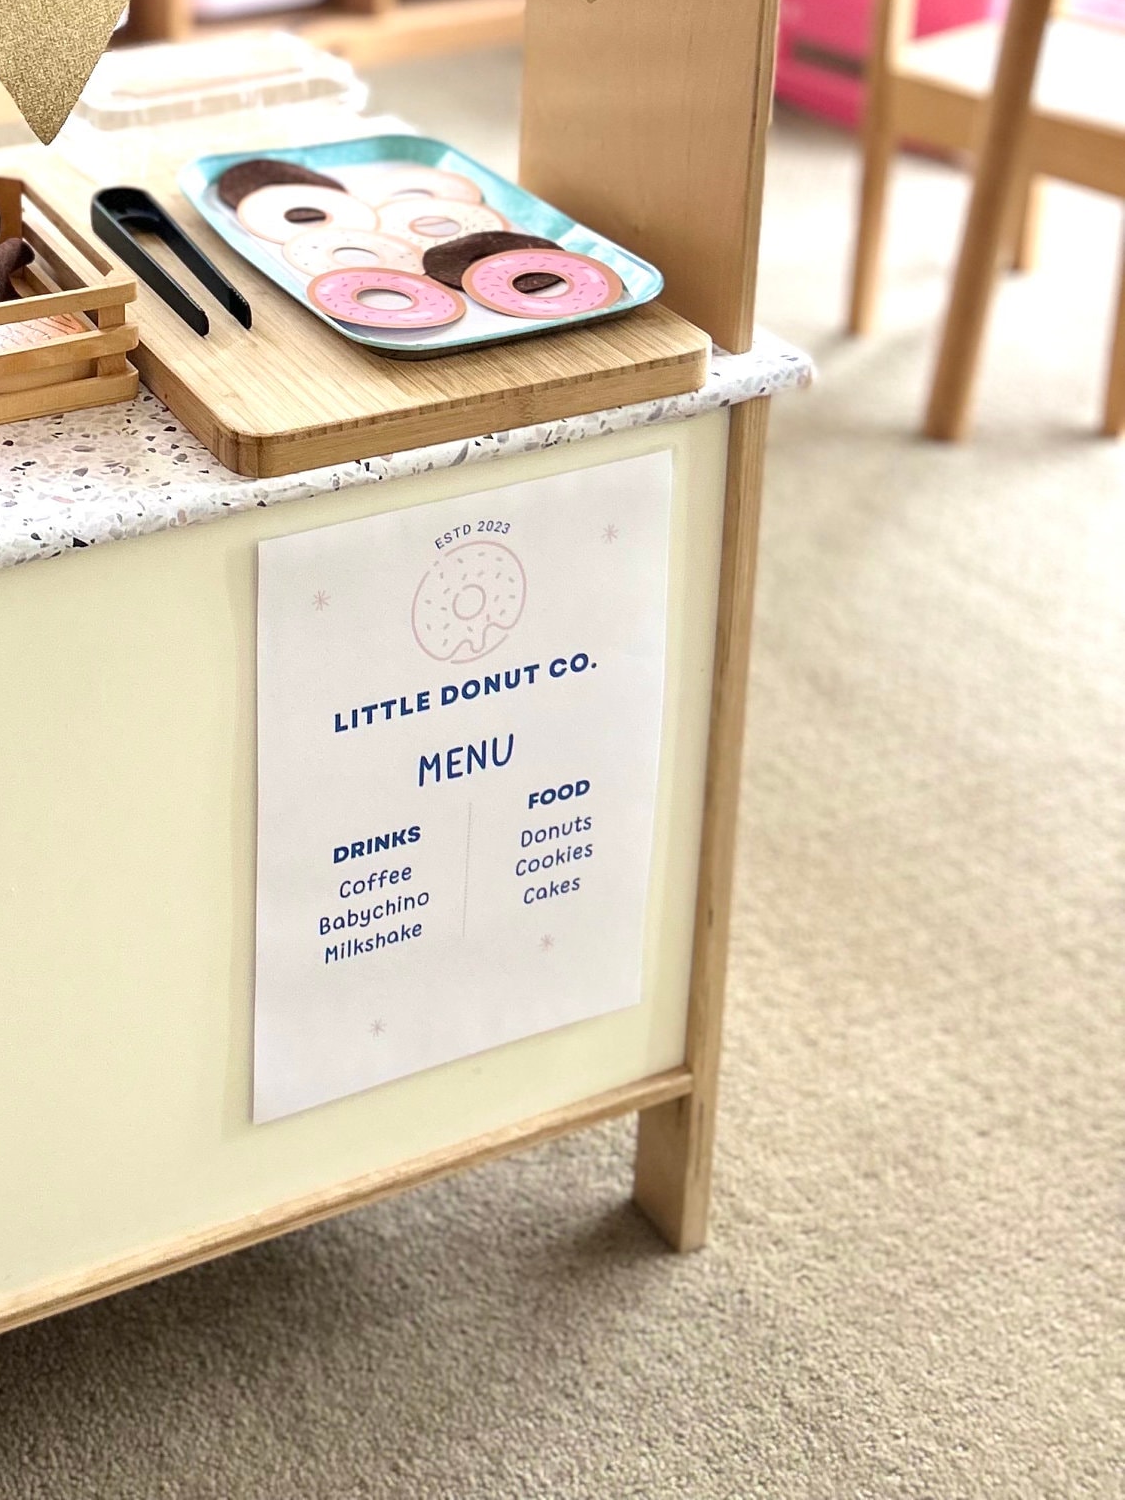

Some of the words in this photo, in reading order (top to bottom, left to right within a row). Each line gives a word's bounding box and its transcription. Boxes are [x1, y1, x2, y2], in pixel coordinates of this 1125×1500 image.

[434, 524, 472, 550] ESTD
[477, 520, 511, 535] 2023
[334, 691, 431, 733] LITTLE
[441, 664, 540, 706] DONUT
[549, 653, 597, 678] CO.
[418, 733, 514, 787] MENU
[528, 779, 590, 809] FOOD
[332, 825, 421, 864] DRINKS
[521, 815, 592, 848] Donuts
[515, 842, 593, 876] Cookies
[339, 866, 412, 899] Coffee
[523, 875, 581, 905] Cakes
[319, 892, 430, 936] Babychino
[325, 922, 423, 964] Milkshake
